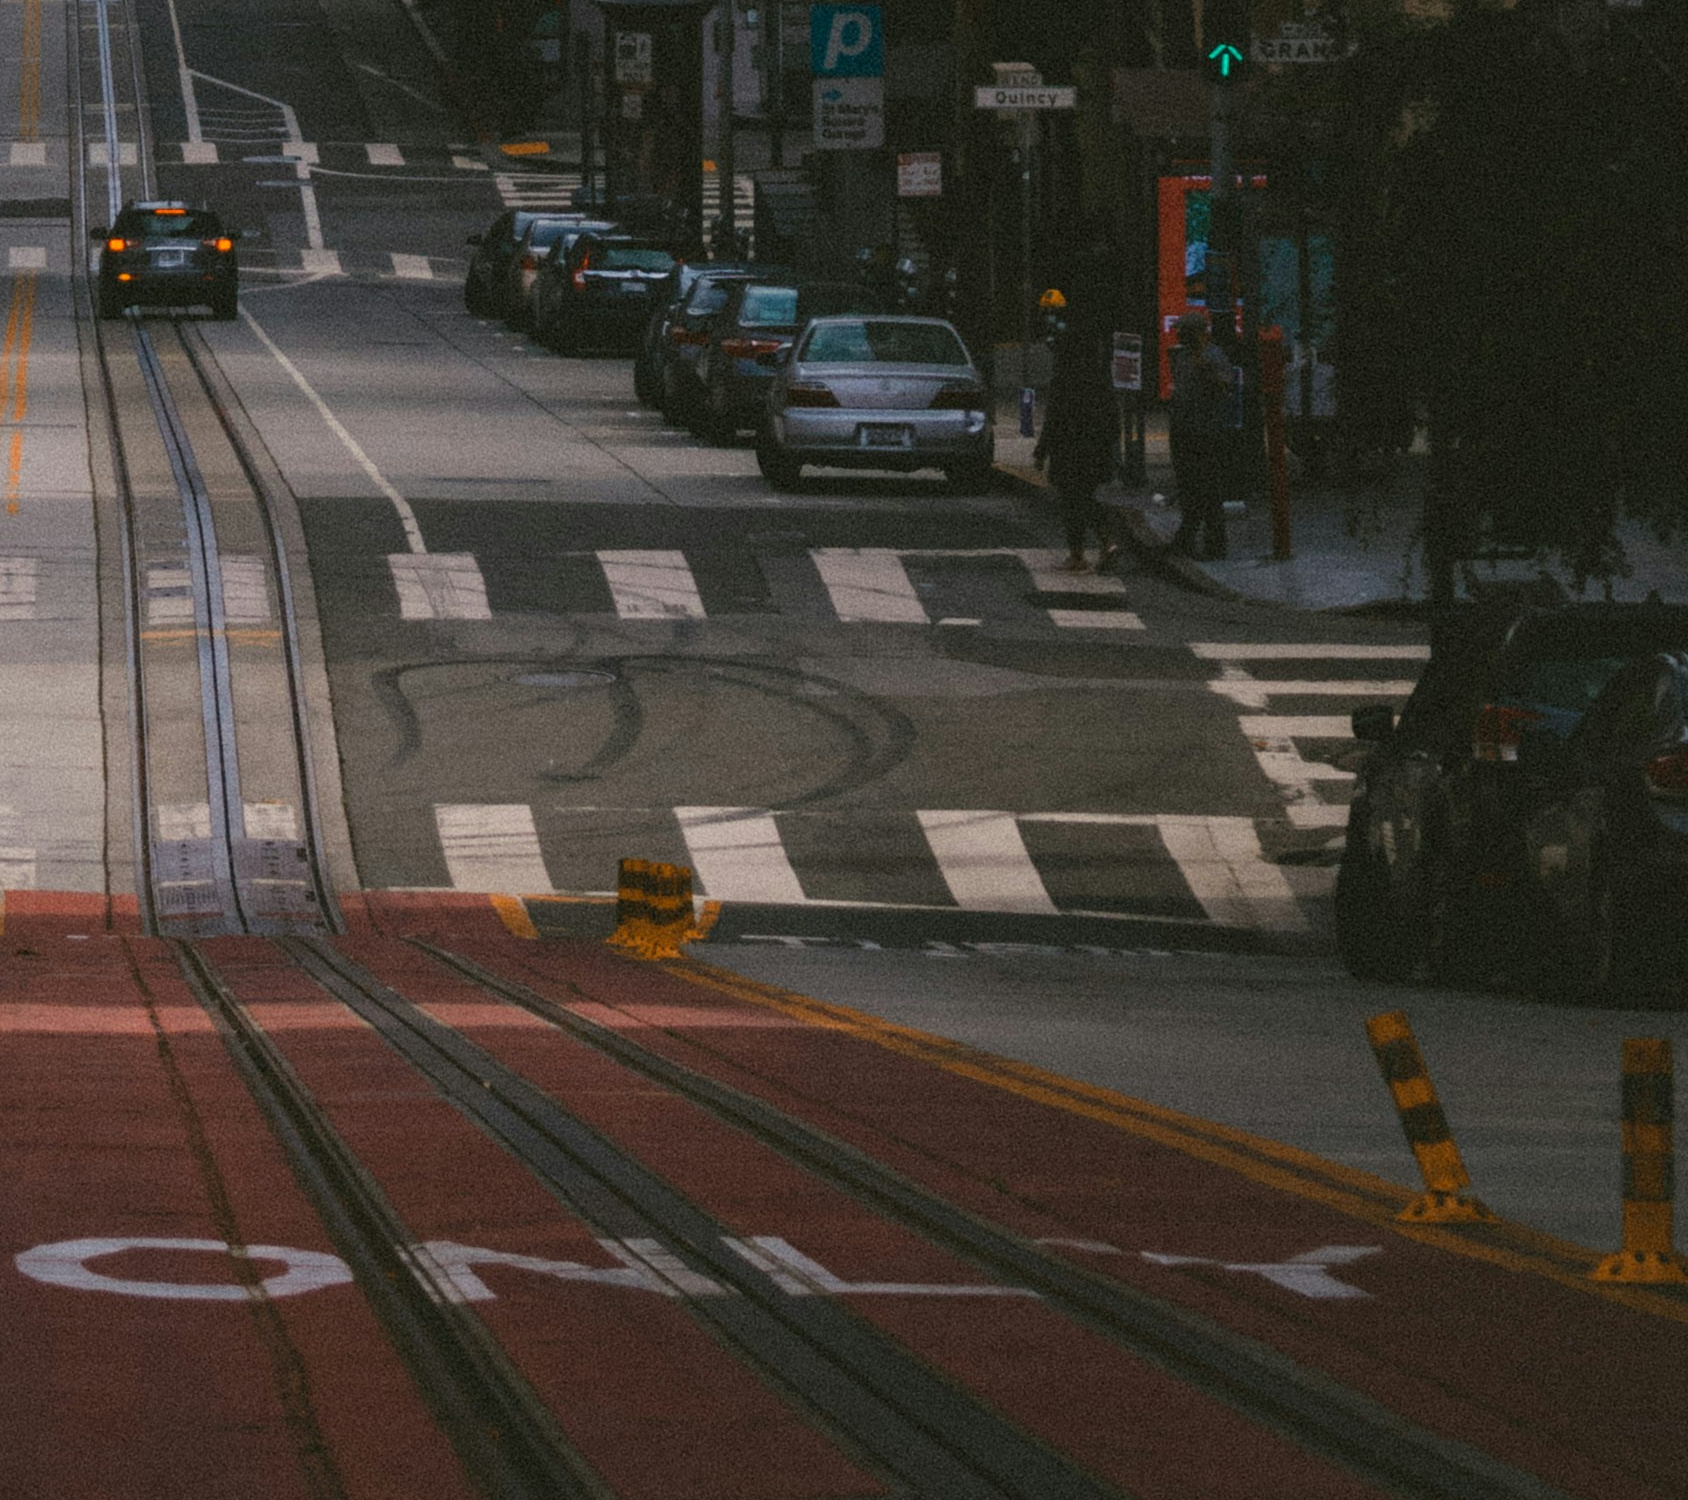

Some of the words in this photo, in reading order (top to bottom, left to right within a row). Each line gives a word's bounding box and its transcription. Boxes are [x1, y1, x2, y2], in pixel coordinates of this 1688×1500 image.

[1258, 41, 1332, 58] GRAN
[995, 90, 1058, 107] Quincy
[14, 1234, 1387, 1302] ONLY
